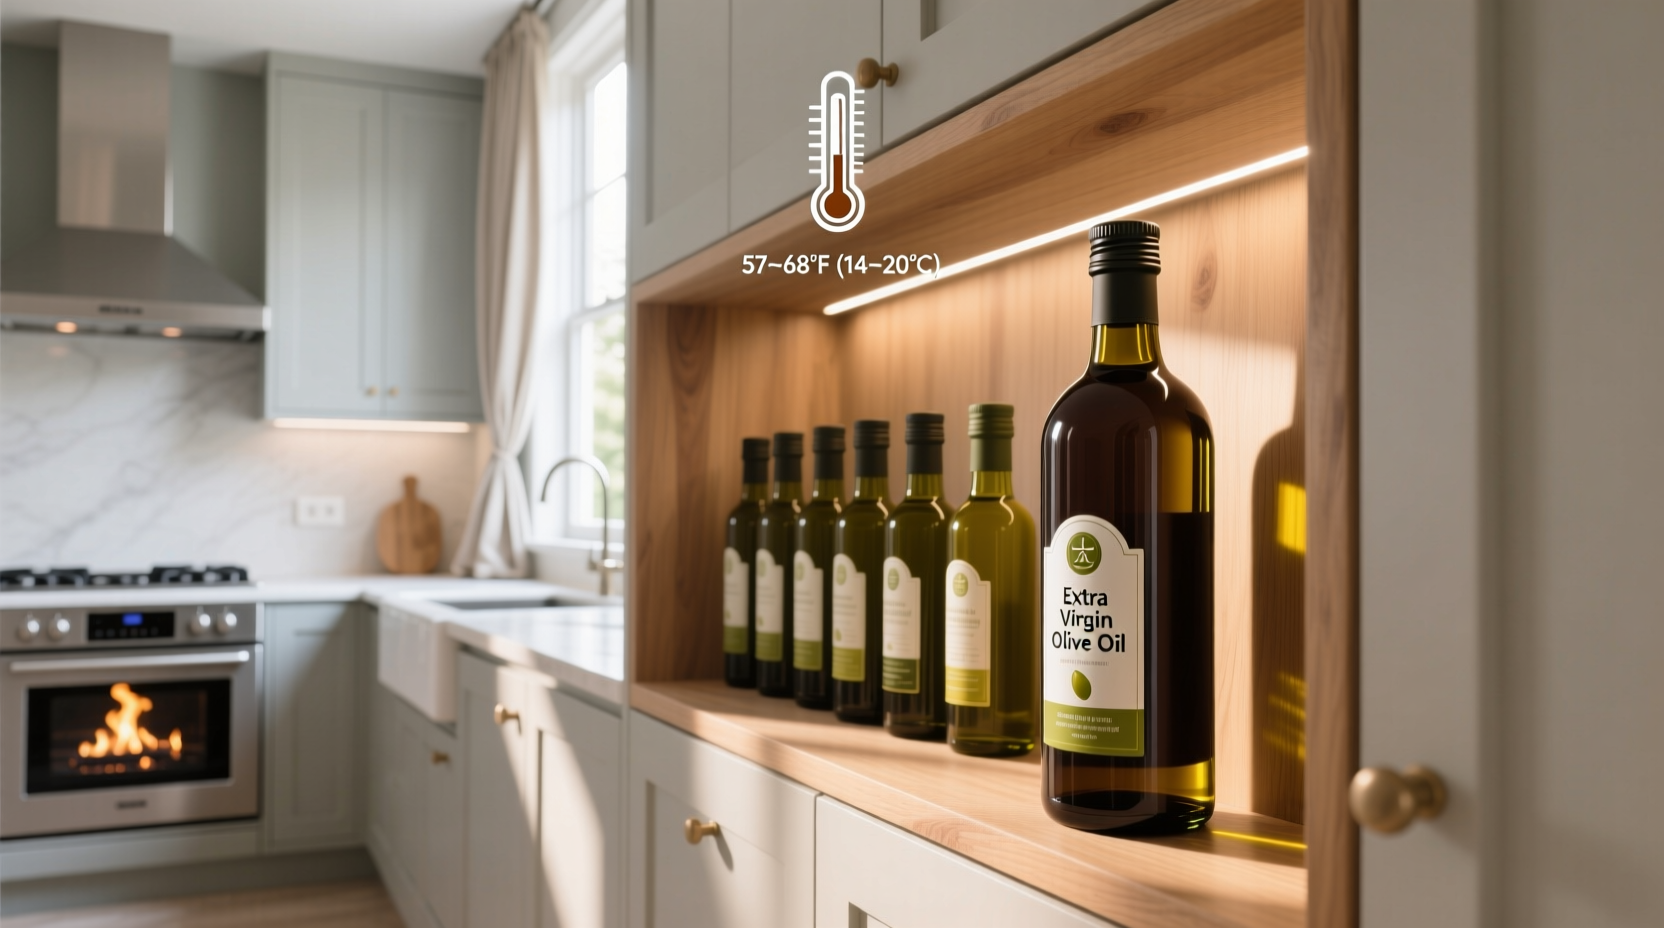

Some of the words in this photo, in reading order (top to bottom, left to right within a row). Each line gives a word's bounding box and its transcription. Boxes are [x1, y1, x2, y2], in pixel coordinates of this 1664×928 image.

[1063, 586, 1108, 606] Extra
[1060, 608, 1113, 632] Virgin
[1052, 630, 1091, 652] Olive
[1097, 633, 1126, 653] Oil
